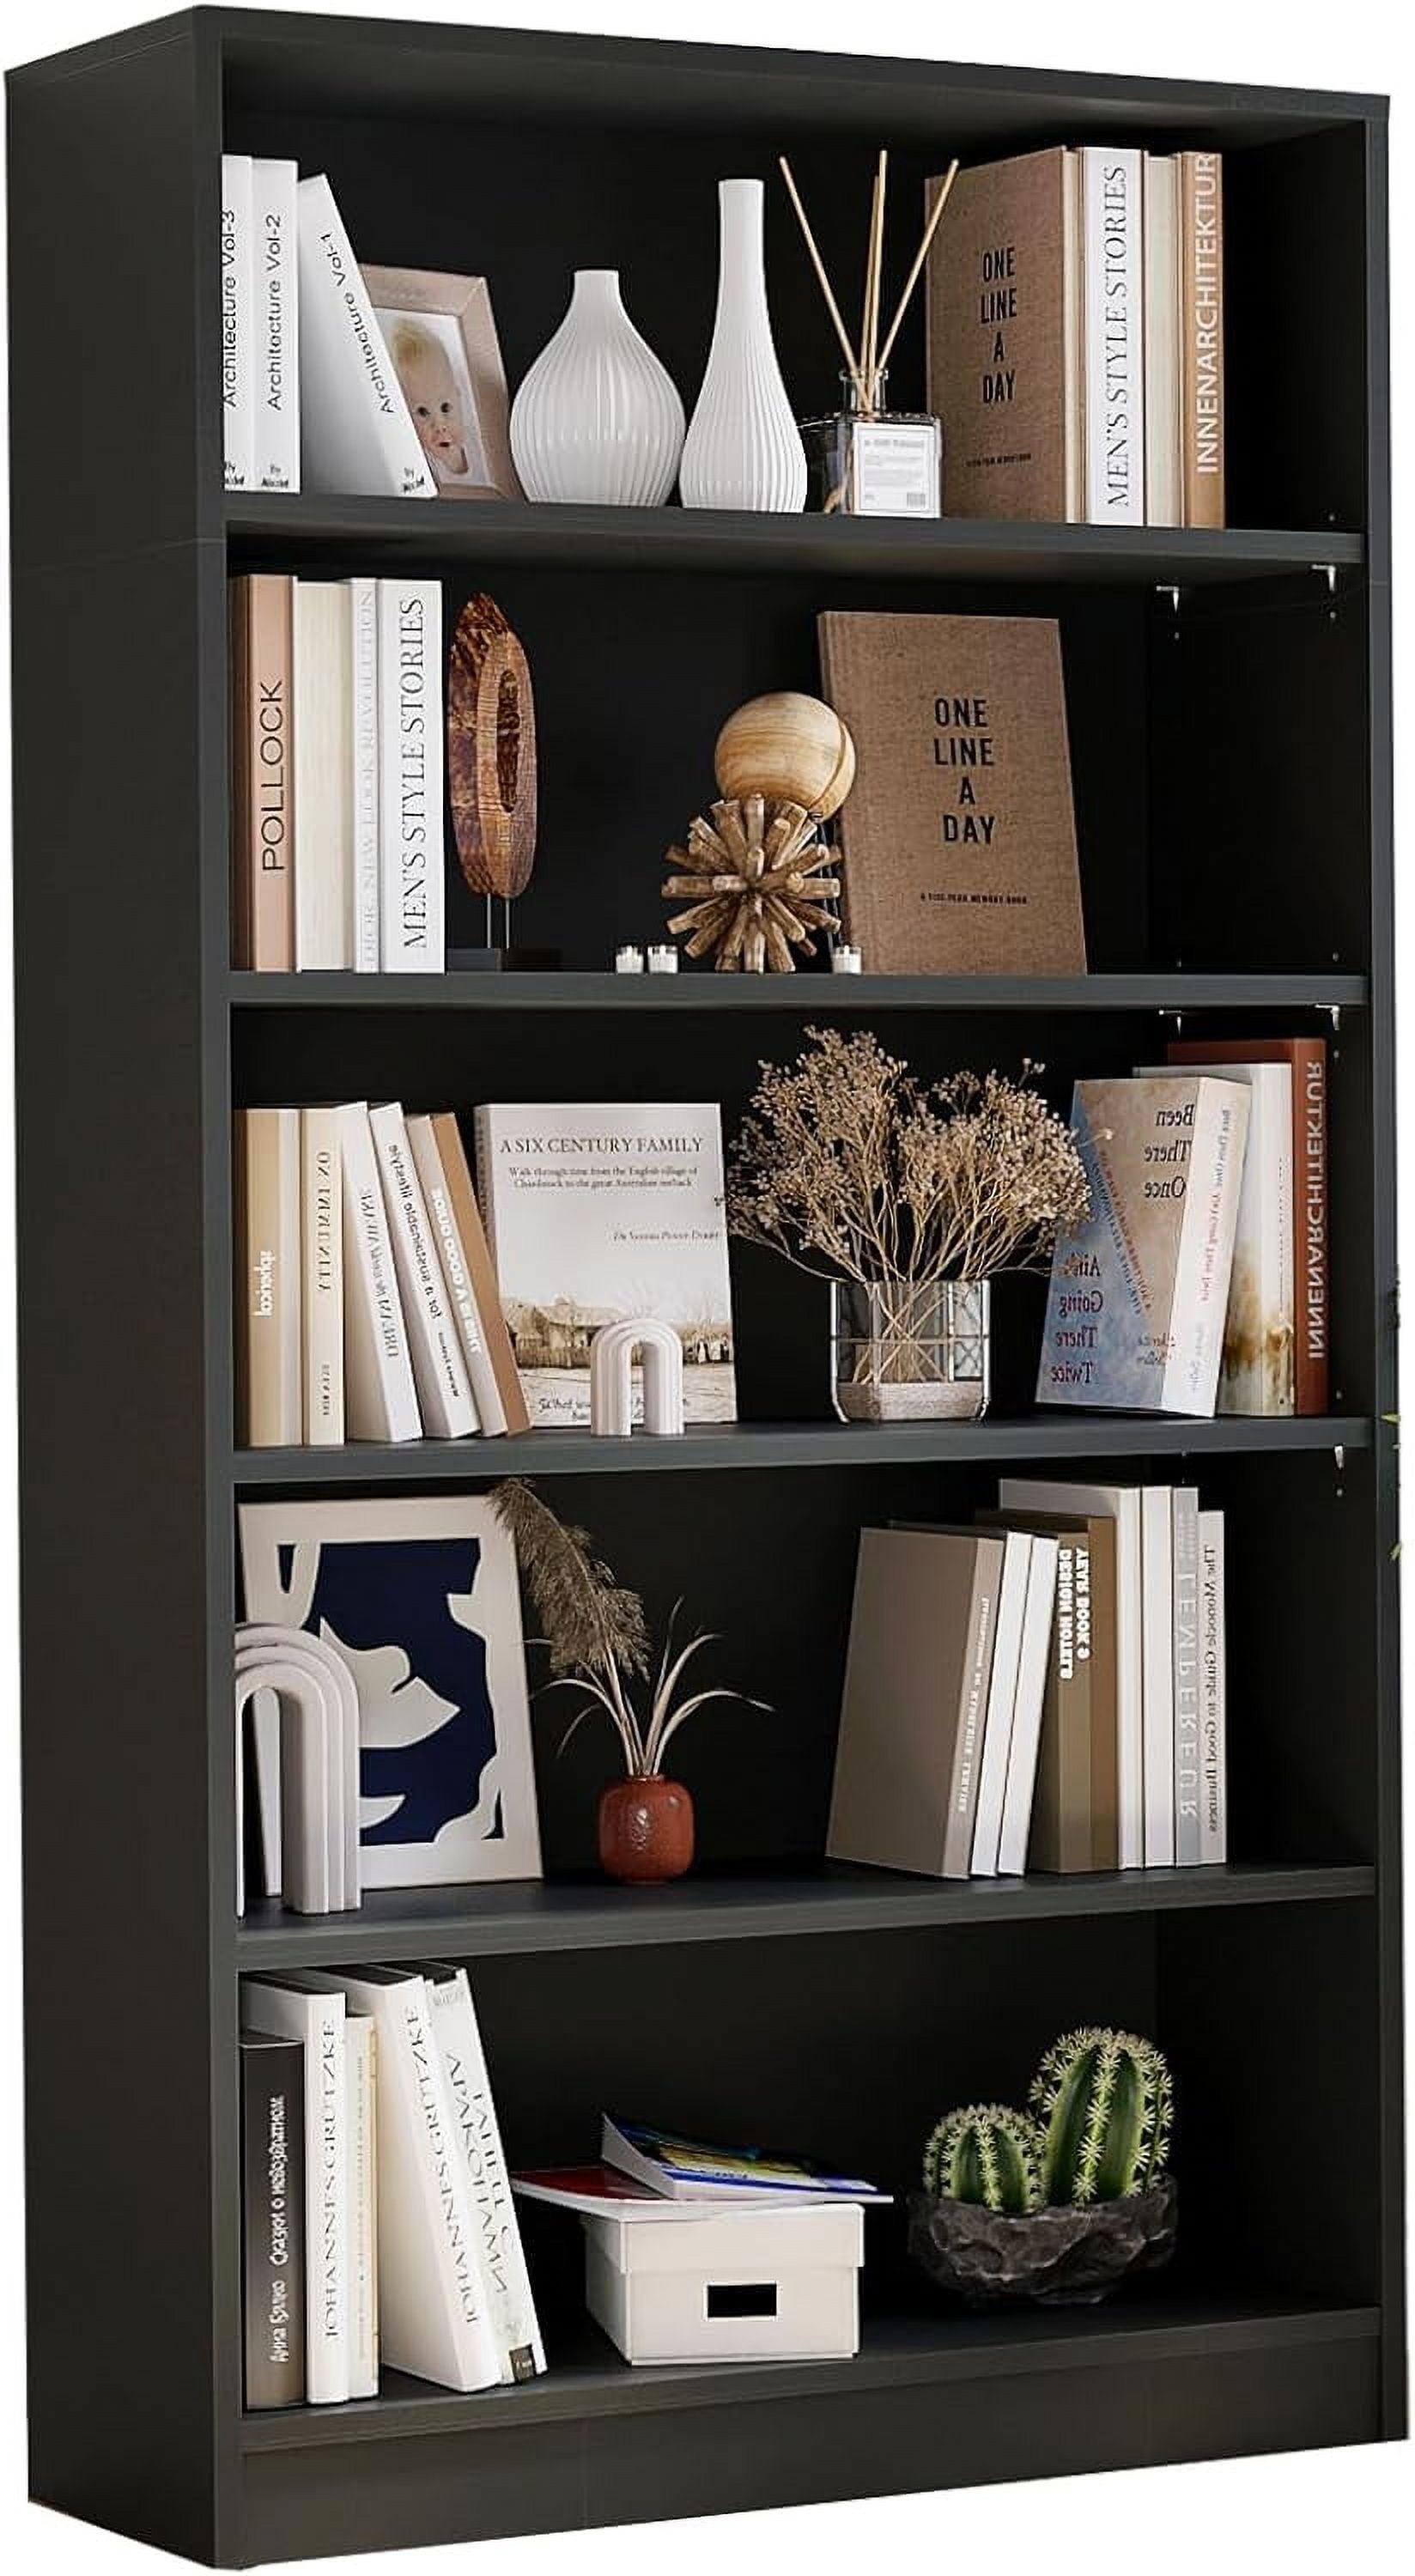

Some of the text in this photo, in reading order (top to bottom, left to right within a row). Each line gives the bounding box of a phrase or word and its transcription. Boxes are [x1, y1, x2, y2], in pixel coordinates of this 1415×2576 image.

[983, 246, 1016, 282] ONE
[265, 214, 282, 411] Architecture Vol-2
[319, 232, 395, 415] Architecture Vol-1
[981, 288, 1017, 325] LINE
[1195, 154, 1218, 473] INNENARCHITEKTUR
[993, 331, 1005, 361] A
[1103, 166, 1129, 507] MEN'S STYLE STORIES
[982, 370, 1016, 404] DAY
[934, 697, 988, 728] ONE
[934, 737, 995, 767] LINE
[259, 680, 285, 871] POLLOCK
[399, 598, 427, 949] MEN'S STYLE STORIES
[958, 776, 975, 805] A
[943, 814, 996, 844] DAY
[500, 1137, 704, 1154] A SIX CENTURY FAMILY
[322, 2175, 339, 2340] JOHANNES
